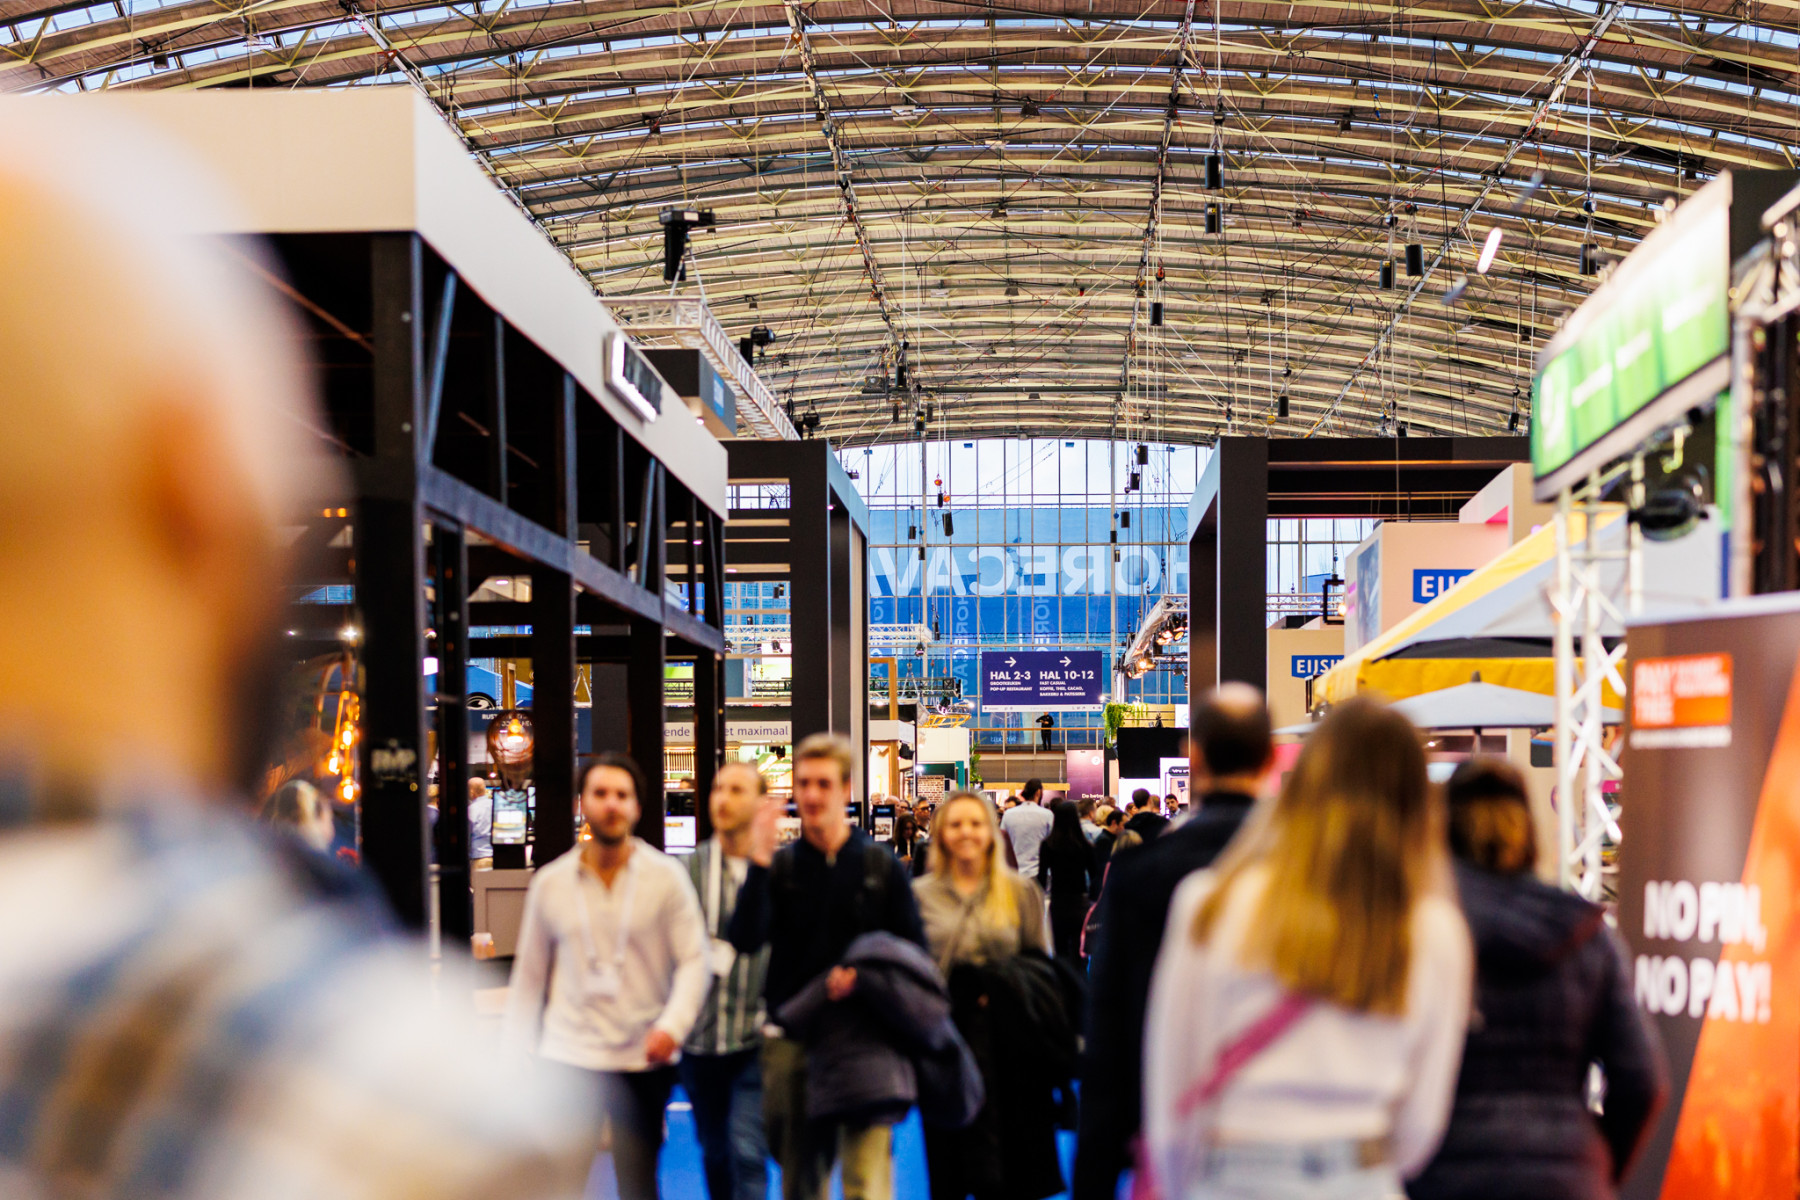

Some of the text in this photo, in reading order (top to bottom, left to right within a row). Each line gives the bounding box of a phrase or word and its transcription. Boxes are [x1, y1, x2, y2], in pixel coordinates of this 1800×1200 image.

[990, 671, 1031, 680] HAL 2-3
[1040, 670, 1094, 680] HAL 10-12
[664, 726, 788, 737] ende et maximaal
[1643, 880, 1767, 953] NO PIN,
[1635, 954, 1772, 1024] NO PAY!
